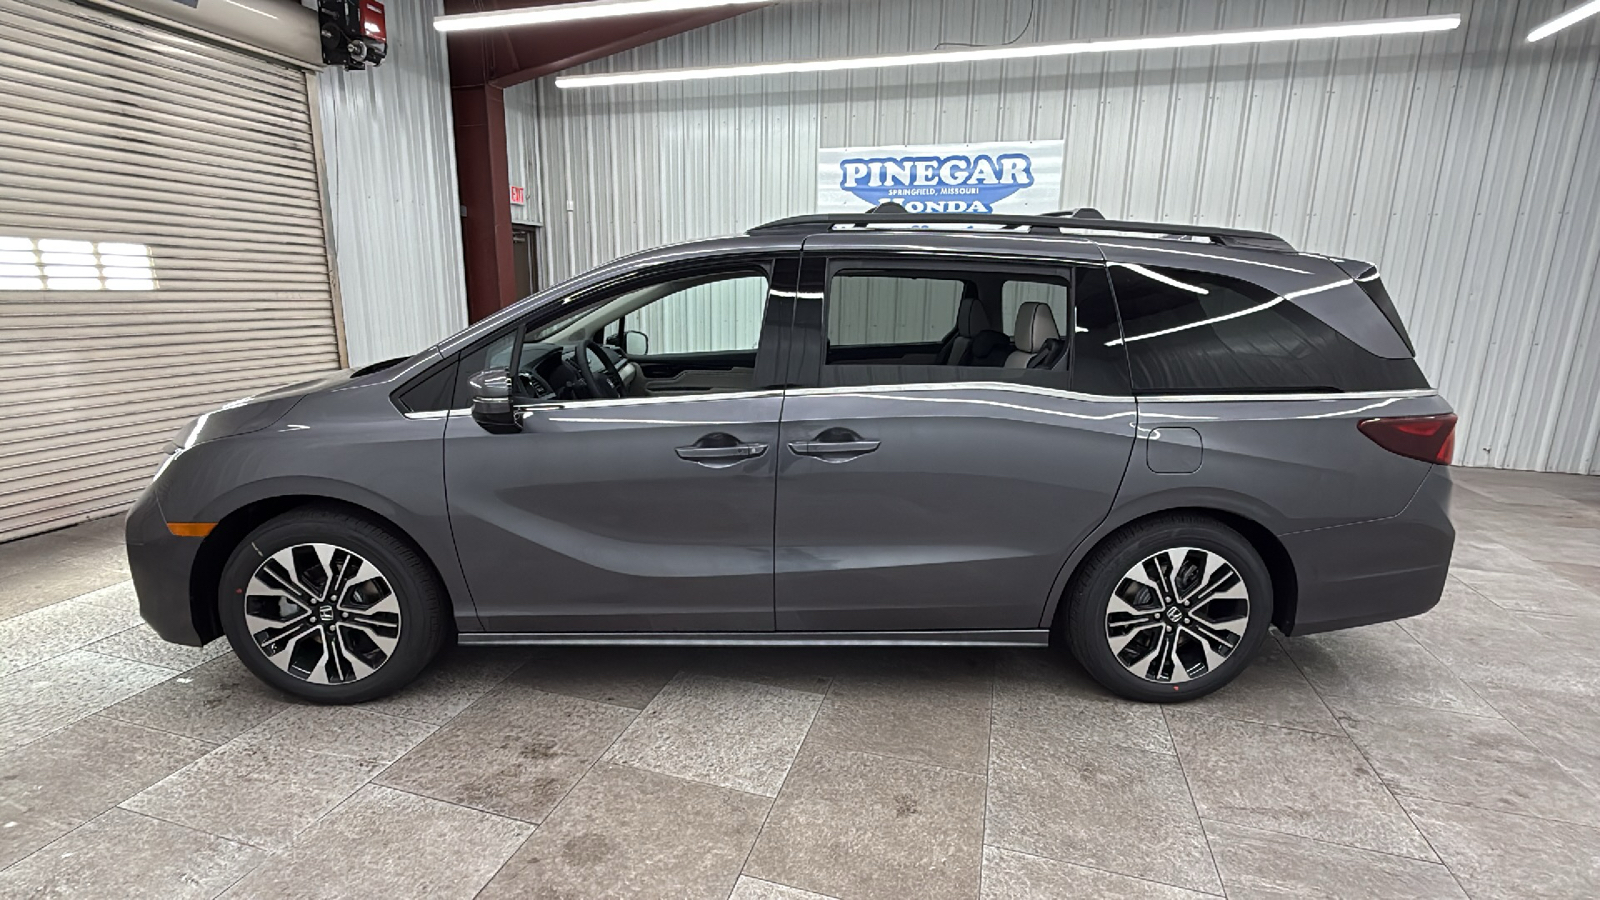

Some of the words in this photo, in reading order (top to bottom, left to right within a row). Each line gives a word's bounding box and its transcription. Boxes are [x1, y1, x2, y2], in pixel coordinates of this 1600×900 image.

[844, 158, 1030, 187] PINEGAR
[511, 186, 524, 203] EXIT
[888, 188, 938, 196] SPRINGFIELD,
[940, 187, 979, 195] MISSOURI
